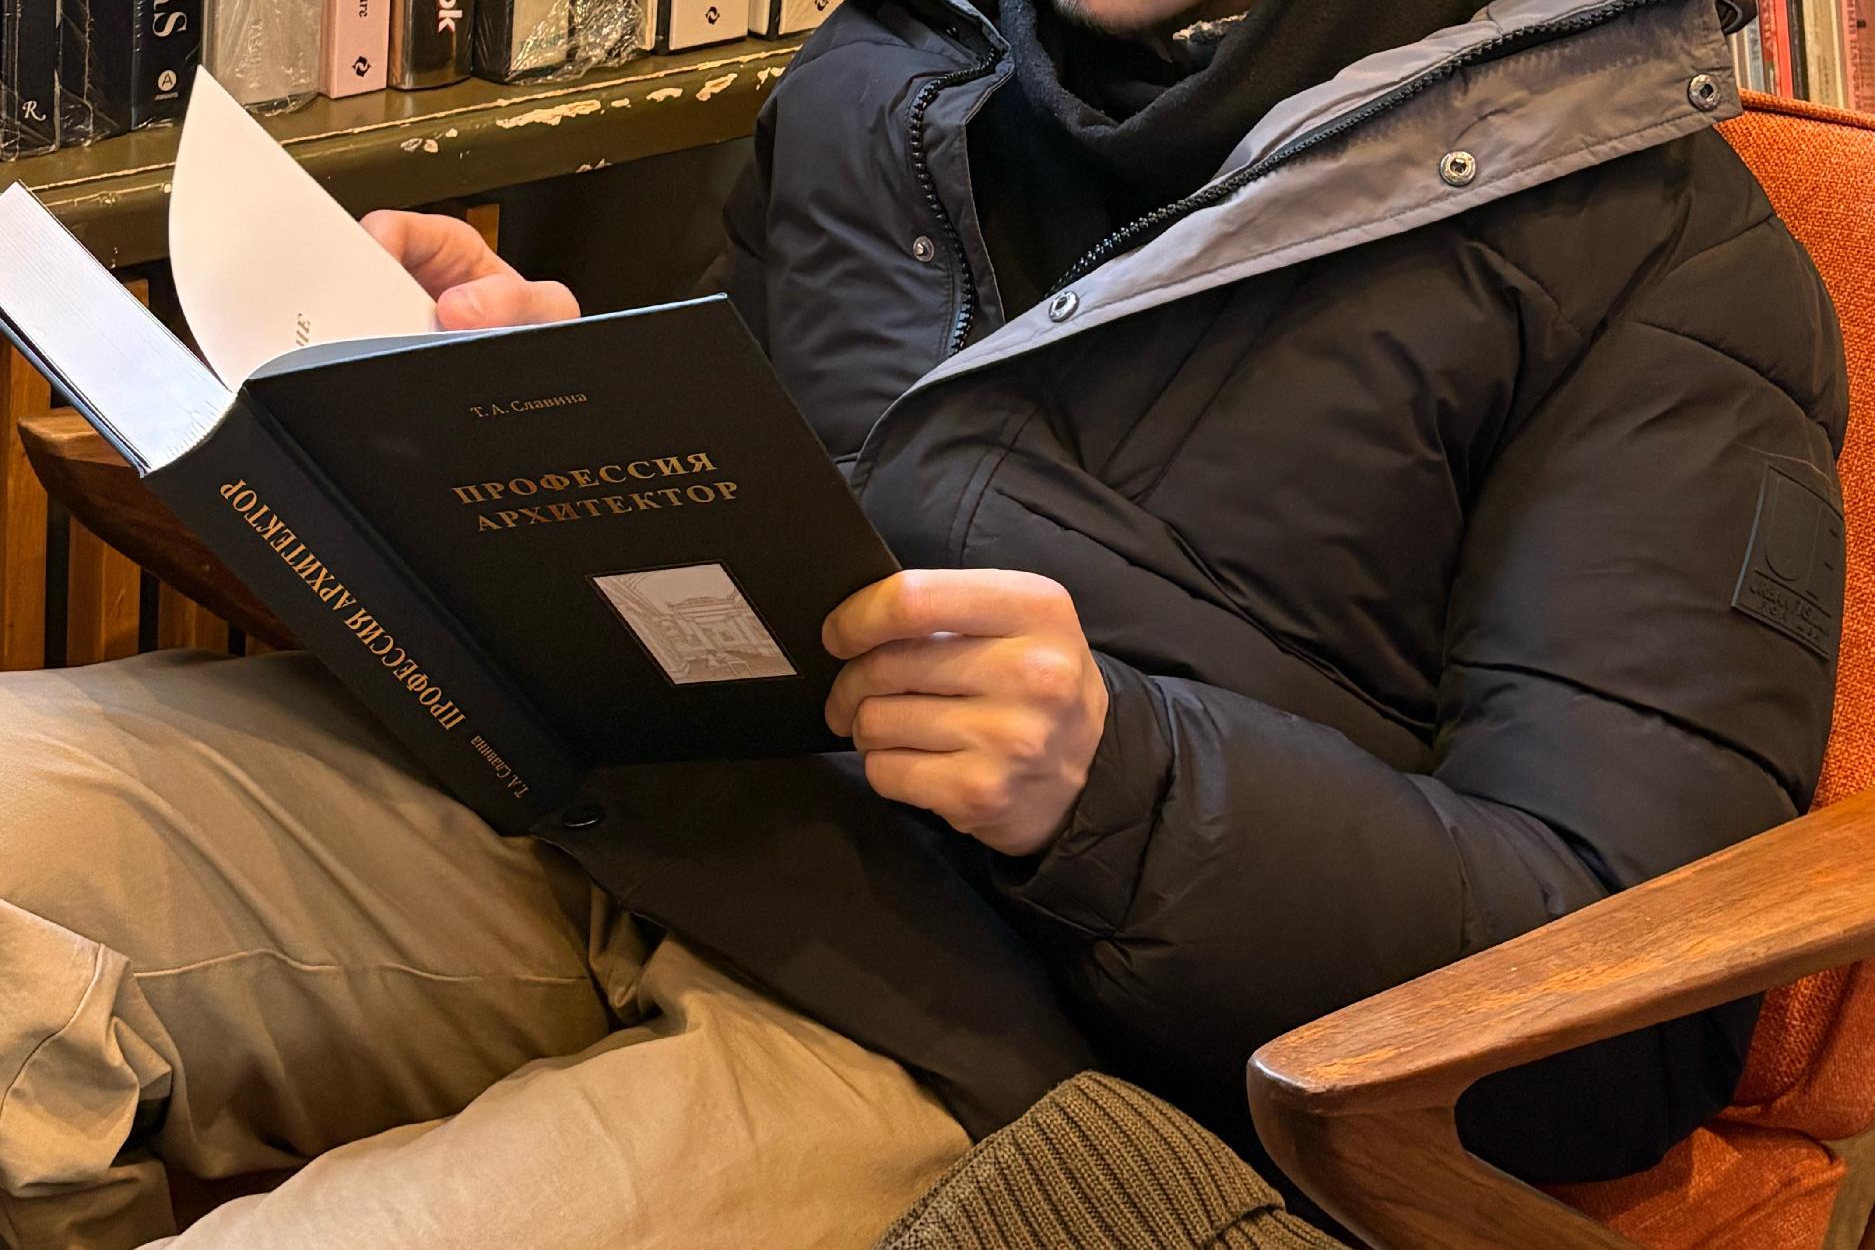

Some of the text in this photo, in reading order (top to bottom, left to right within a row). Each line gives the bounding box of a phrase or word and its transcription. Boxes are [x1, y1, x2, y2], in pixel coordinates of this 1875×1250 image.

[470, 392, 588, 418] Т. А. Славина
[452, 452, 718, 504] ПРОФЕССИЯ
[477, 480, 738, 533] АРХИТЕКТОР
[219, 478, 358, 612] АРХИТЕКТОР
[344, 608, 466, 731] ПРОФЕССИЯ
[470, 735, 511, 780] Славина
